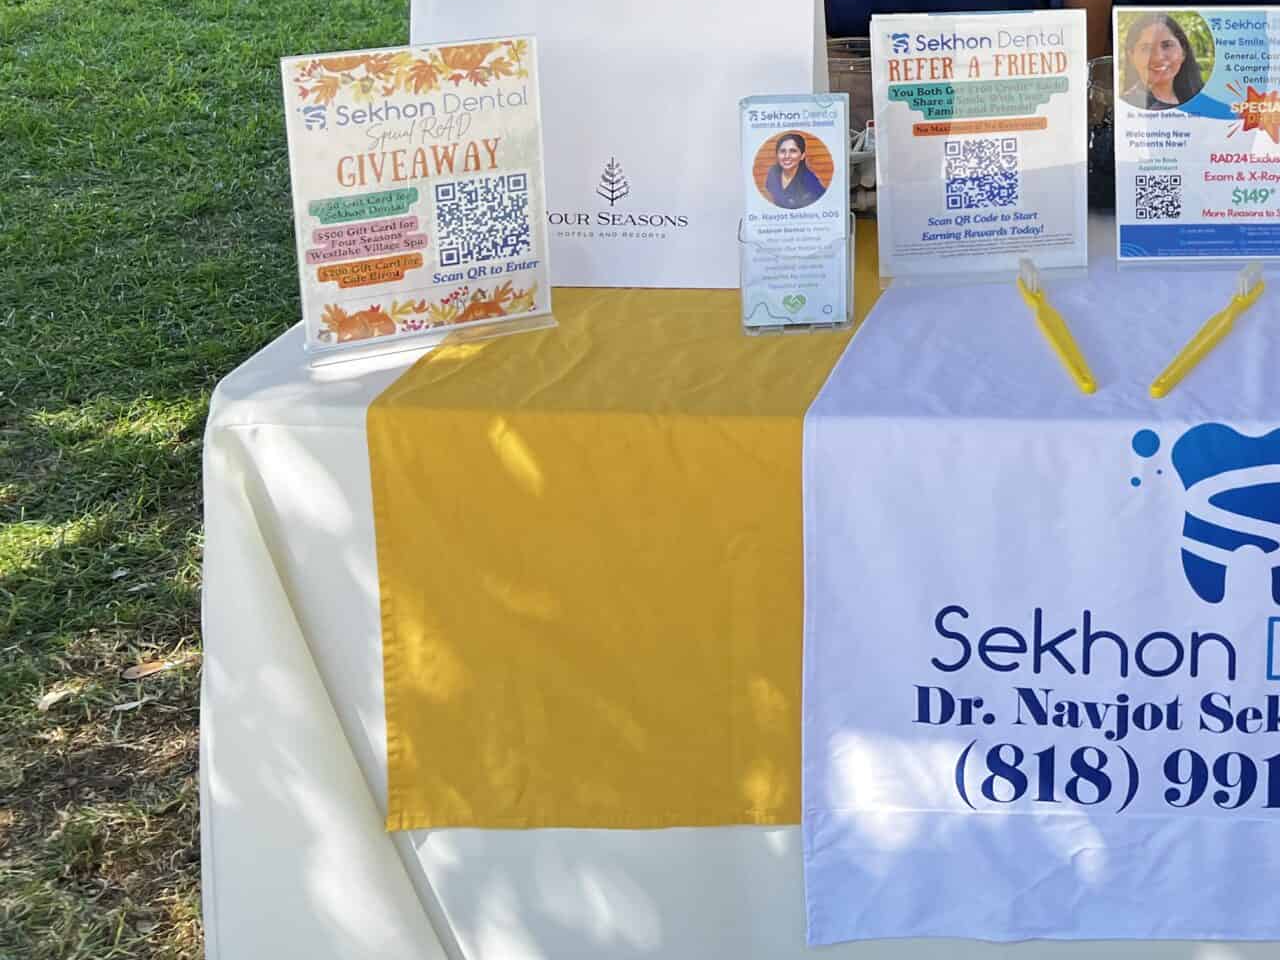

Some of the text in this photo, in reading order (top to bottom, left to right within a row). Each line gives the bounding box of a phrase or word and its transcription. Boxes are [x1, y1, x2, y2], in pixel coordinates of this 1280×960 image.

[915, 29, 1065, 52] Sekhon Dental
[888, 51, 1068, 82] REFER A FRIEND
[892, 88, 914, 97] You
[917, 86, 944, 97] Both
[336, 86, 529, 126] Sekhon Dental
[913, 97, 944, 107] Share
[1126, 130, 1191, 139] Welcoming New
[336, 137, 502, 188] GIVEAWAY
[1210, 153, 1249, 164] RAD24
[1204, 171, 1234, 181] Exam
[1236, 172, 1245, 181] &
[546, 211, 689, 228] OUR SEASONS
[927, 211, 1038, 226] Scan QR Code to Start
[1202, 208, 1226, 218] More
[1227, 208, 1263, 218] Reasons
[1265, 209, 1275, 217] to
[346, 226, 367, 237] Gift
[371, 222, 397, 233] Card
[557, 231, 594, 239] HOTELS
[922, 224, 1044, 243] Earning Rewards Today!
[310, 238, 424, 261] Westlake Village Spa
[432, 259, 541, 285] Scan QR to Enter
[930, 603, 1238, 682] Sekhon
[911, 684, 996, 728] Dr.
[1014, 687, 1185, 743] Navjot
[953, 738, 1141, 814] (818)
